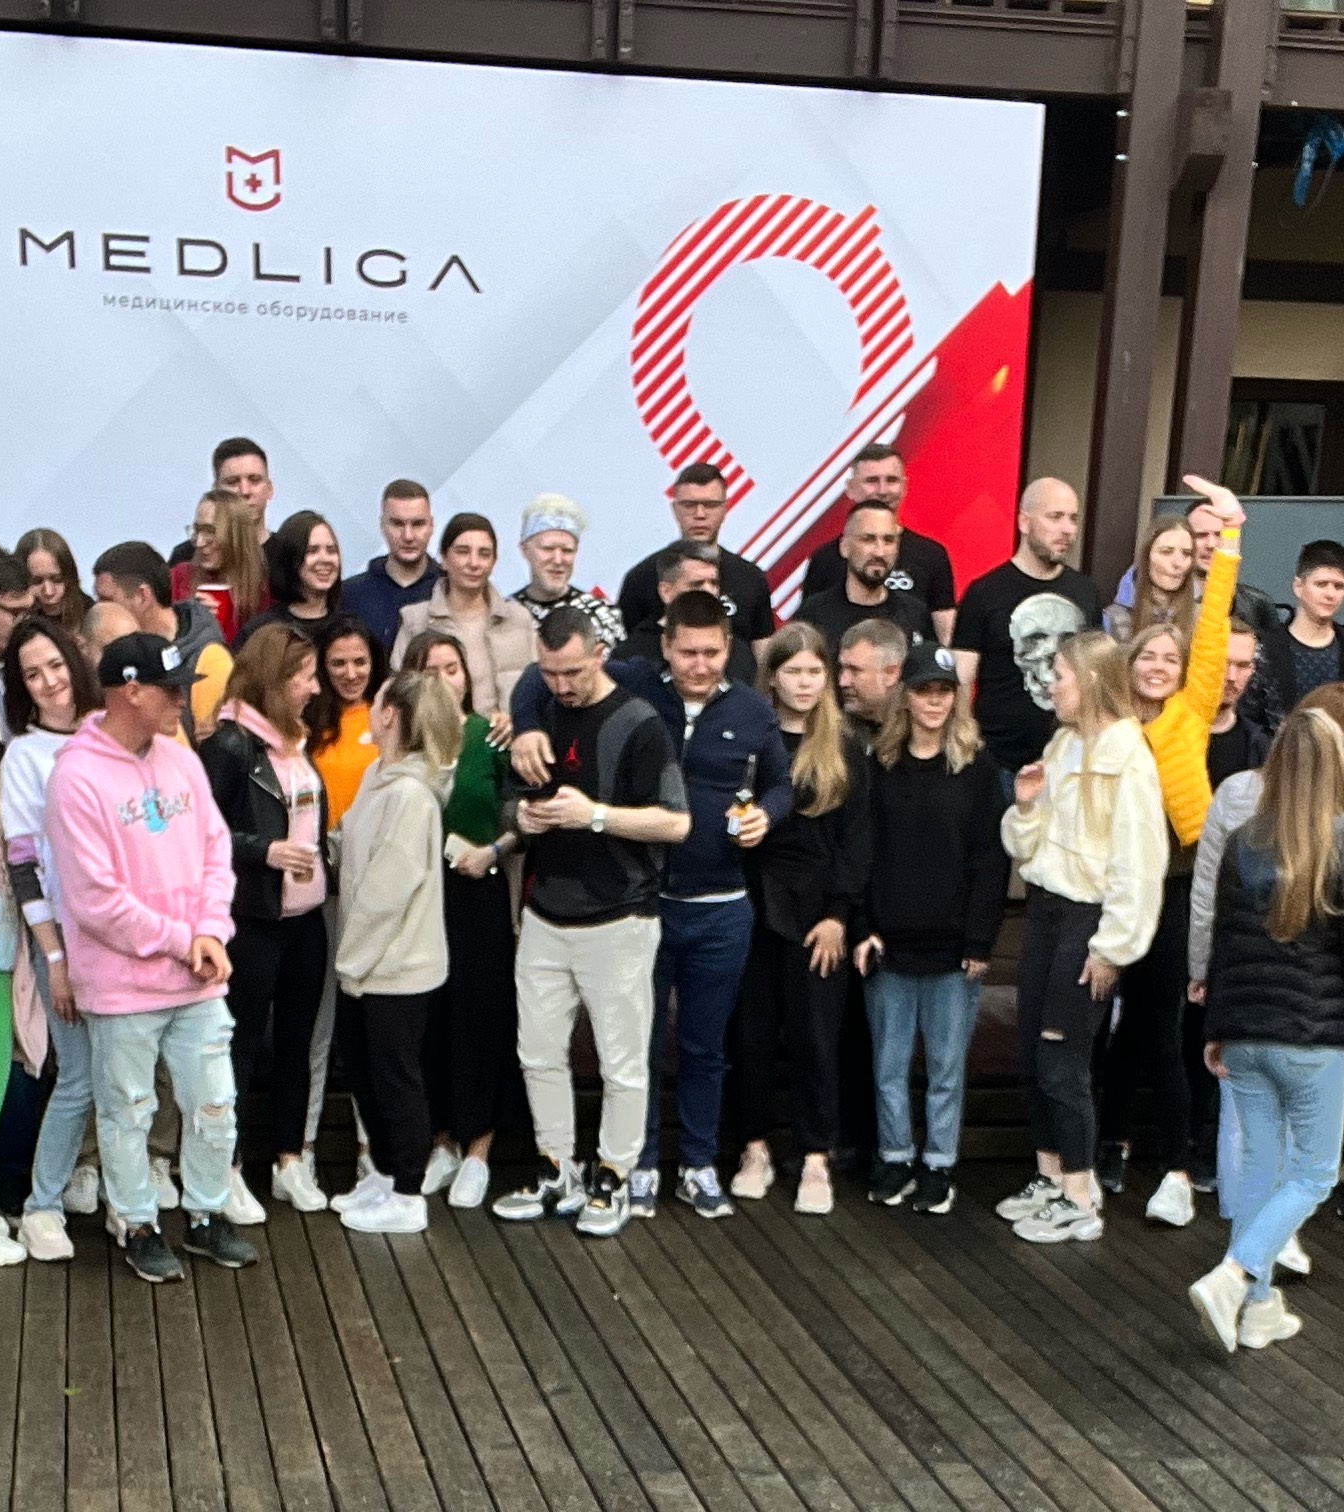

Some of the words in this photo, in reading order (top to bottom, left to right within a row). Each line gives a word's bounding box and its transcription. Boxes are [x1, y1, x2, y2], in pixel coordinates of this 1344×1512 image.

[18, 227, 482, 293] MEDLIGA
[102, 294, 249, 317] медицинское
[256, 300, 410, 324] оборудование
